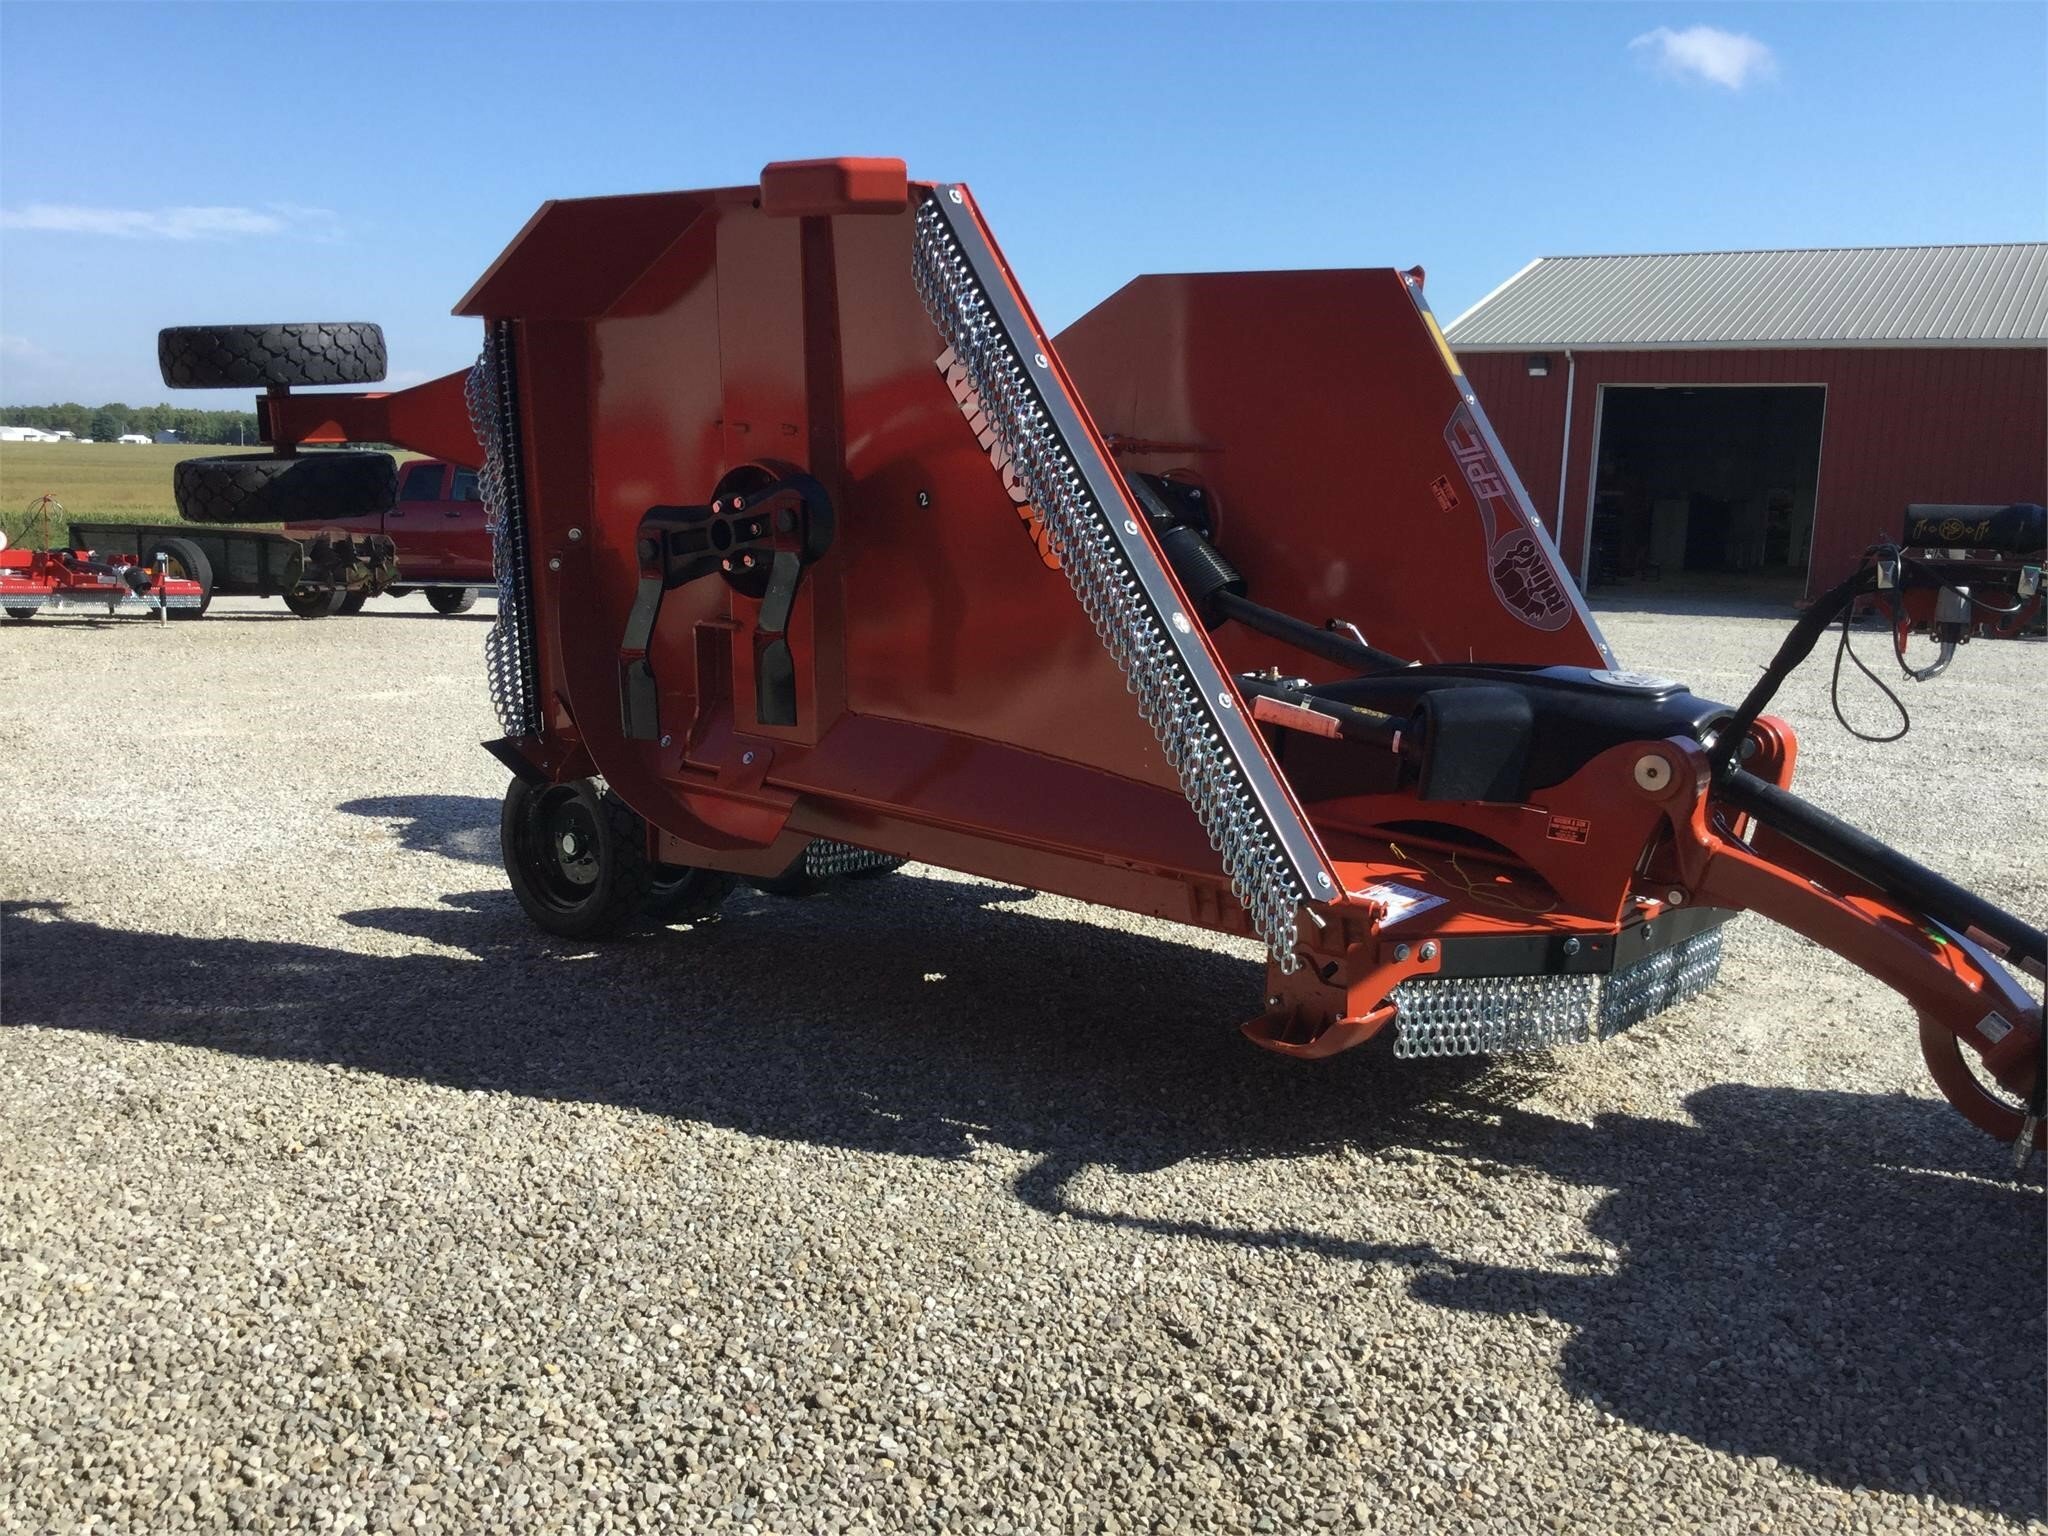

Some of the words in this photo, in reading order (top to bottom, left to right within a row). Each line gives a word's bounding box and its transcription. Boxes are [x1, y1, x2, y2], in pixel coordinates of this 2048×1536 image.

[919, 492, 929, 506] 2
[1451, 433, 1506, 500] EPIC
[1515, 537, 1568, 616] RHINO
